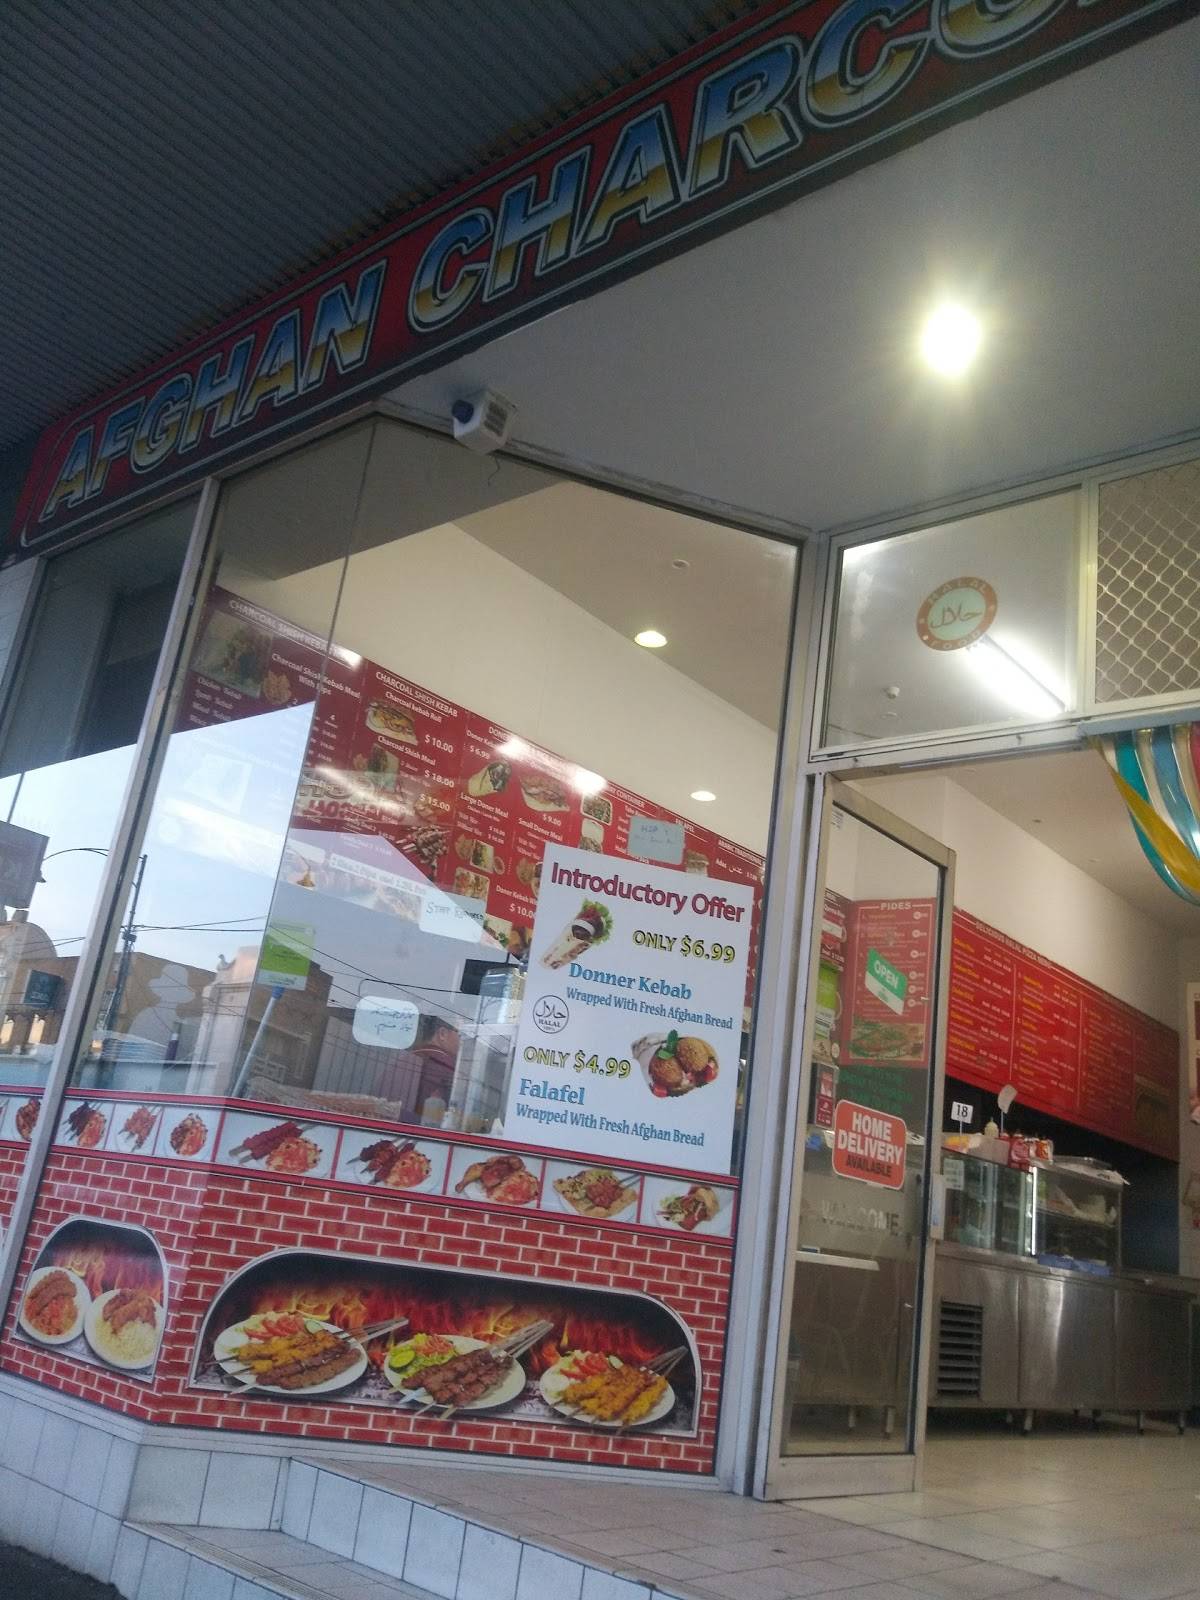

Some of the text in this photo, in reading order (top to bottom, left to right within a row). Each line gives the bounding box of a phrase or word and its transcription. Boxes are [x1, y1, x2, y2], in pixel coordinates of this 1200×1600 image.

[38, 0, 1095, 524] AFGHAN CHARC
[375, 671, 458, 717] CHARCOAL SHISH KEBAB
[551, 862, 745, 922] Introductory Offer
[880, 902, 912, 911] PIDES
[633, 929, 736, 963] ONLY $6.99
[568, 963, 692, 1000] Donner Kebab
[874, 959, 900, 989] OPEN
[566, 987, 733, 1029] Wrapped With Fresh Afghan Bread
[523, 1045, 631, 1078] ONLY $4.99
[519, 1078, 586, 1106] Falafel
[516, 1103, 705, 1146] Wrapped With Fresh Afghan Bread
[852, 1111, 892, 1142] HOME
[957, 1104, 968, 1118] 18
[837, 1129, 903, 1165] DELIVERY
[846, 1155, 892, 1178] AVAILABLE
